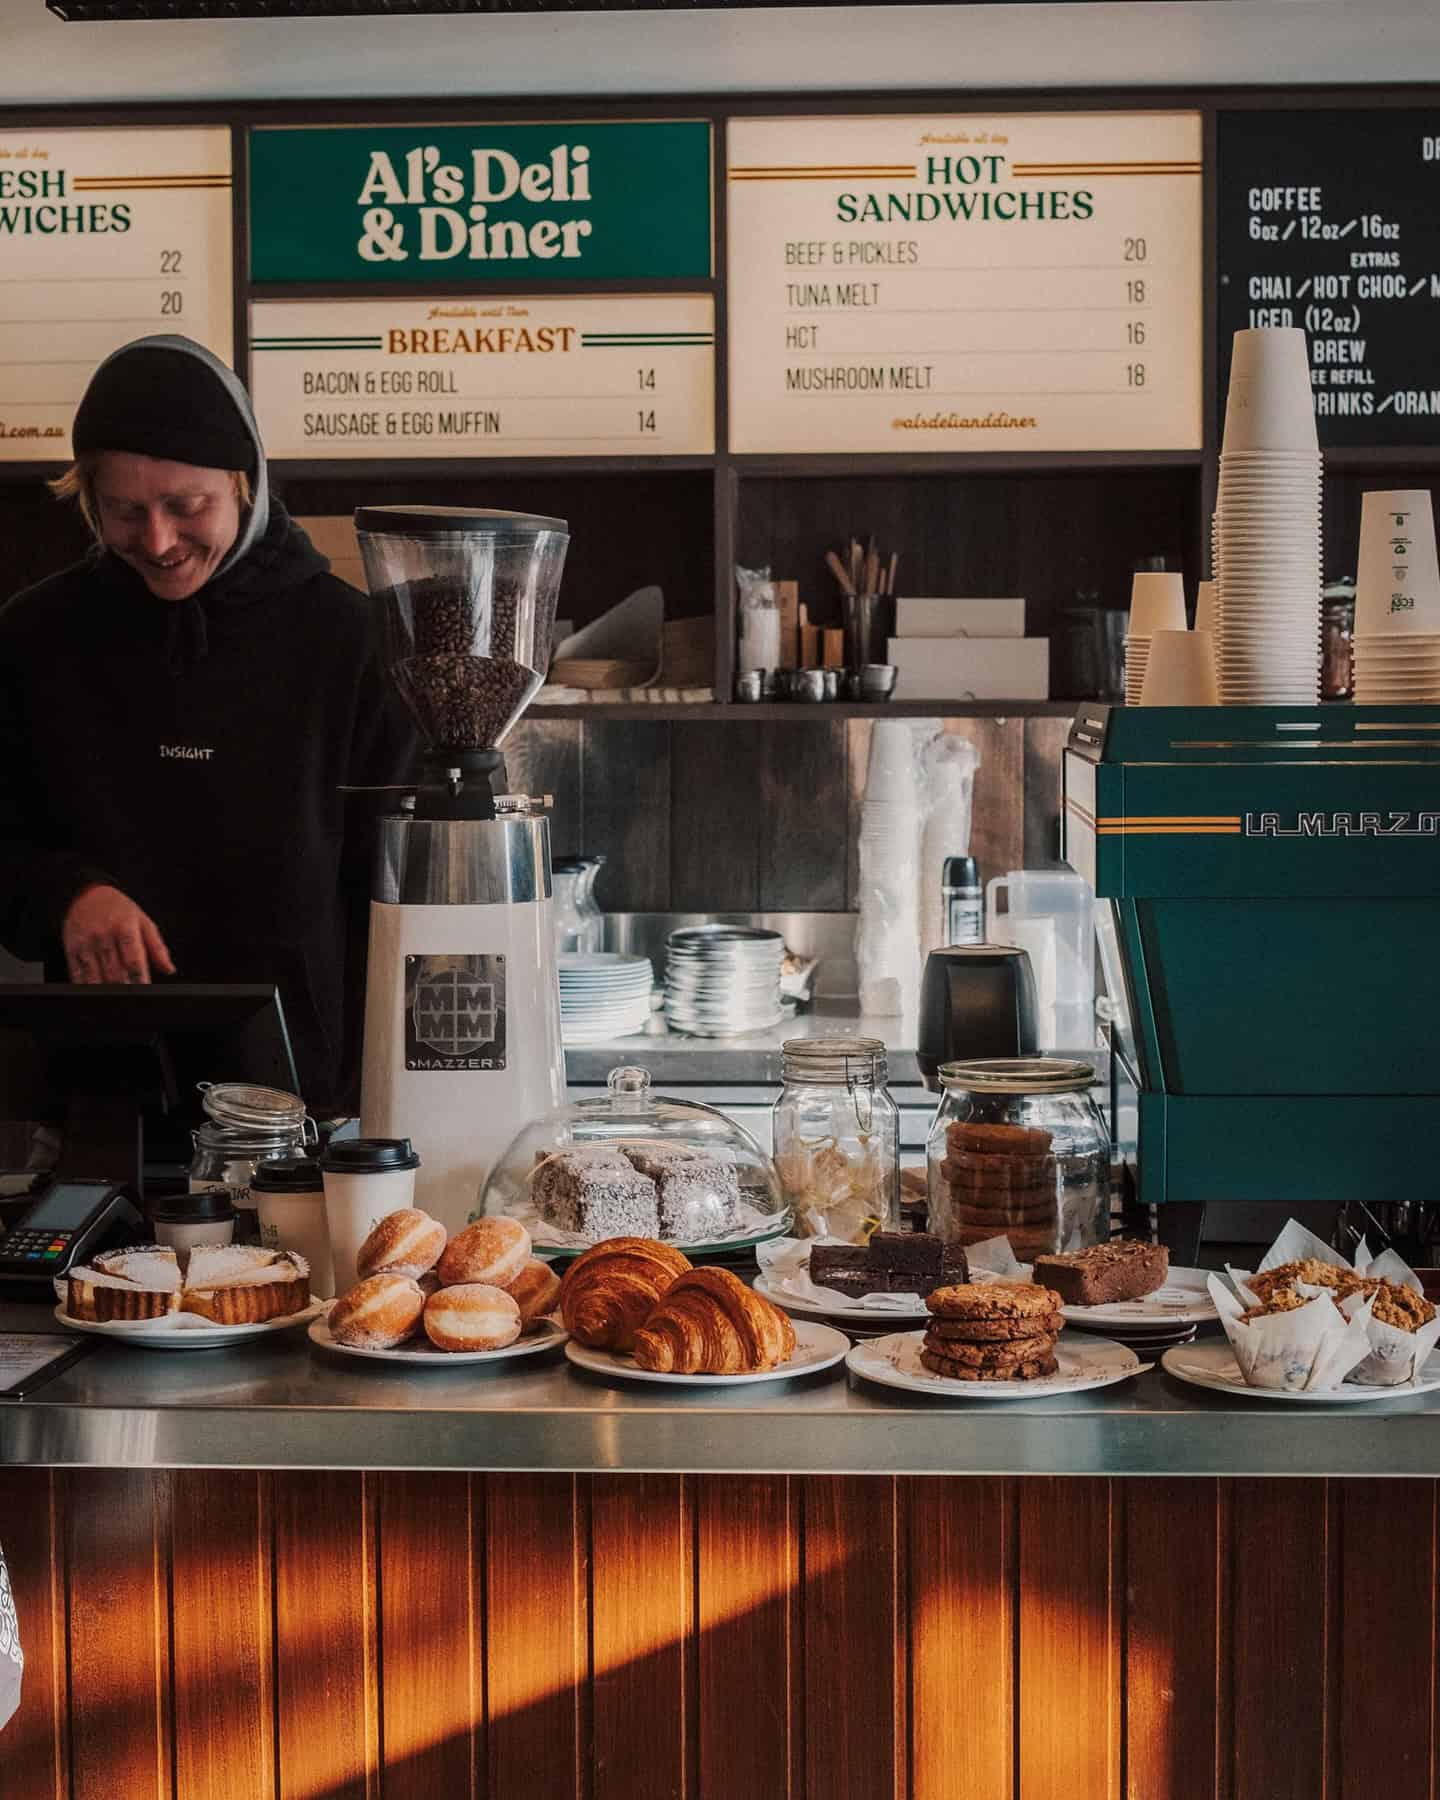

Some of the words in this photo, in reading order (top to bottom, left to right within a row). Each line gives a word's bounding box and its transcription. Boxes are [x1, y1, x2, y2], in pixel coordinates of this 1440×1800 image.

[357, 145, 465, 205] Al's
[471, 144, 593, 203] Deli
[926, 155, 1006, 185] HOT
[0, 170, 66, 199] ESH
[836, 190, 1095, 223] SANDWICHES
[1249, 187, 1322, 211] COFFEE
[357, 207, 409, 262] &
[418, 203, 593, 261] Diner
[160, 249, 182, 273] 22
[785, 241, 826, 265] BEEF
[832, 241, 844, 265] &
[849, 240, 919, 264] PICKLES
[1124, 237, 1146, 261] 20
[1350, 252, 1400, 268] EXTRAS
[160, 290, 182, 315] 20
[786, 284, 831, 307] TUNA
[836, 282, 880, 306] MELT
[1126, 279, 1146, 304] 18
[1249, 307, 1293, 329] ICED
[1305, 303, 1360, 333] (12oz)
[387, 326, 576, 355] BREAKFAST
[786, 325, 818, 349] HCT
[1126, 321, 1146, 345] 16
[1313, 339, 1366, 364] BREW
[303, 371, 359, 395] BACON
[365, 371, 376, 394] &
[381, 370, 413, 394] EGG
[417, 370, 459, 394] ROLL
[637, 368, 656, 390] 14
[786, 366, 884, 391] MUSHROOM
[889, 365, 934, 389] MELT
[1126, 362, 1146, 387] 18
[1330, 368, 1376, 385] REFILL
[303, 412, 380, 436] SAUSAGE
[386, 411, 397, 434] &
[402, 411, 433, 434] EGG
[438, 410, 500, 434] MUFFIN
[637, 410, 656, 432] 14
[1245, 812, 1280, 837] LA
[1299, 811, 1440, 837] MARZO
[417, 1058, 494, 1069] MAZZER
